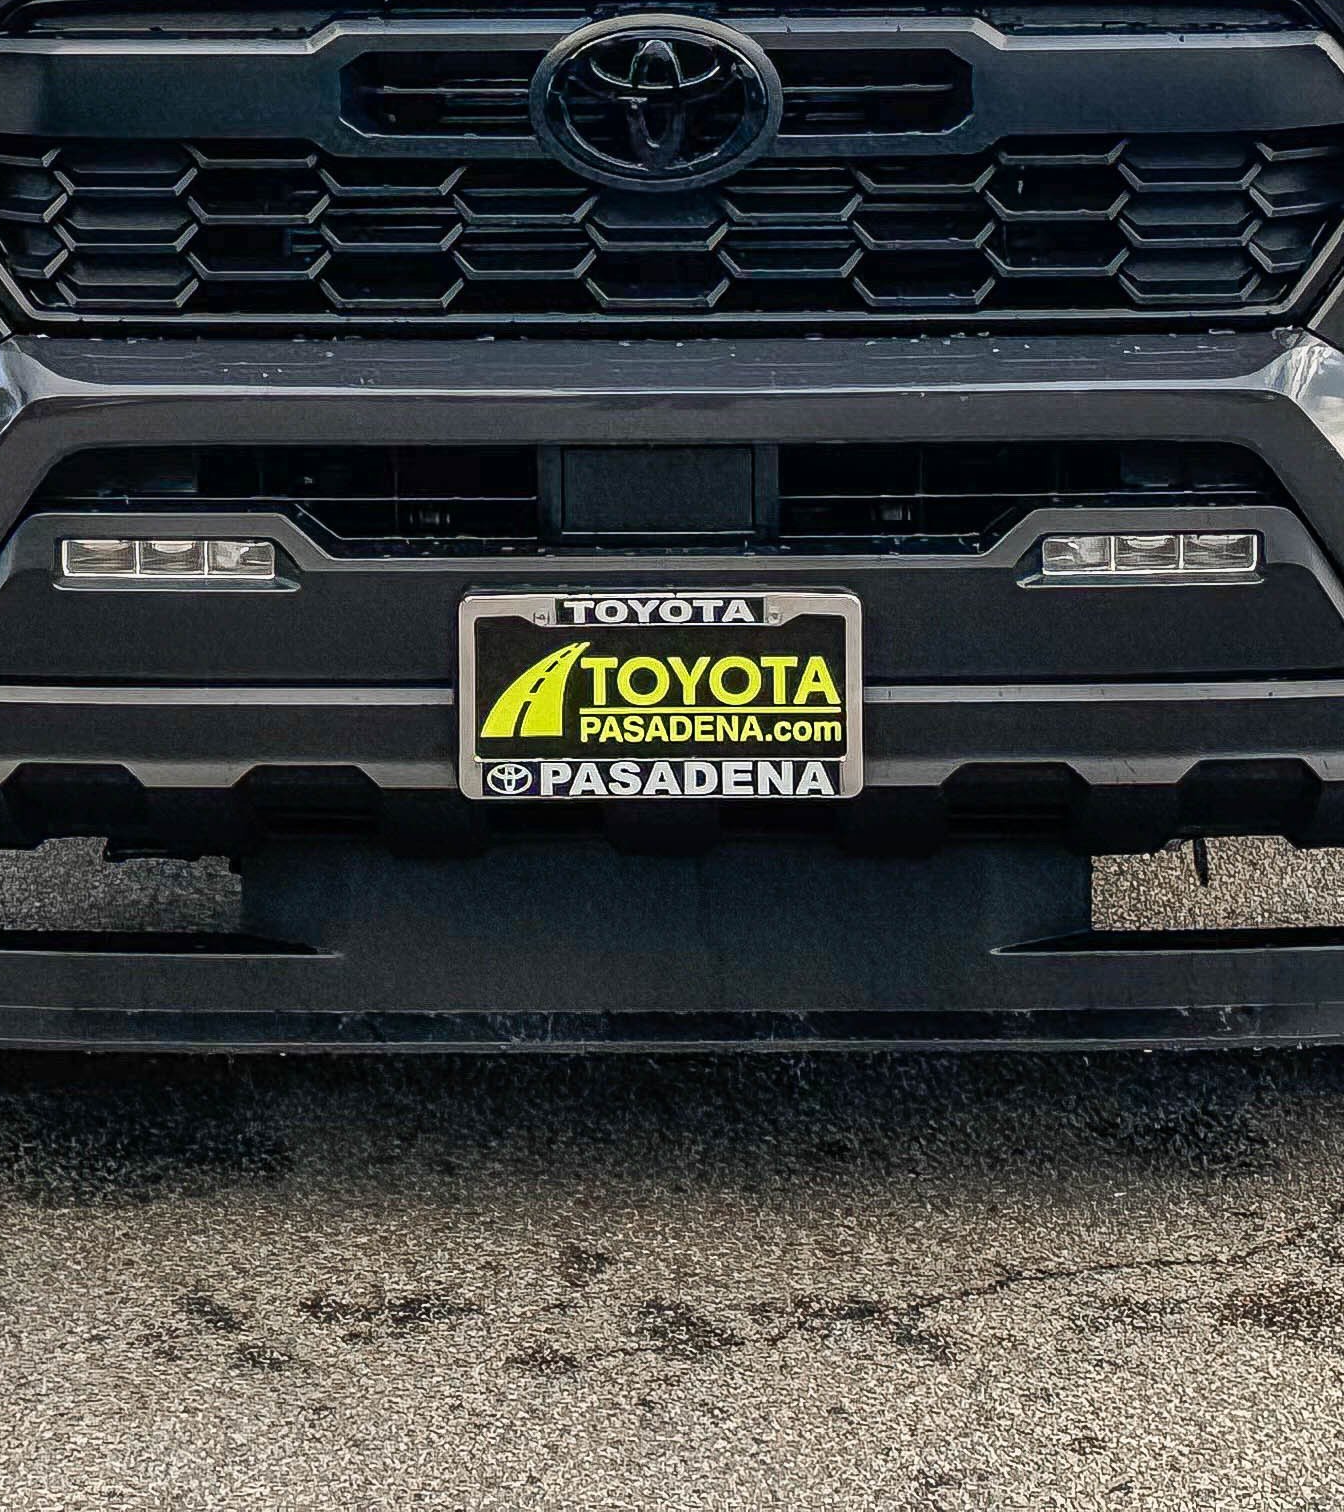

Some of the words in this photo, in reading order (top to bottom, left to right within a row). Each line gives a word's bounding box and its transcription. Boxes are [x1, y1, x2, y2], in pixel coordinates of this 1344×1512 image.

[563, 599, 754, 624] TOYOTA
[580, 656, 841, 706] TOYOTA
[580, 715, 842, 743] PASADENA.com
[540, 761, 835, 796] PASADENA
